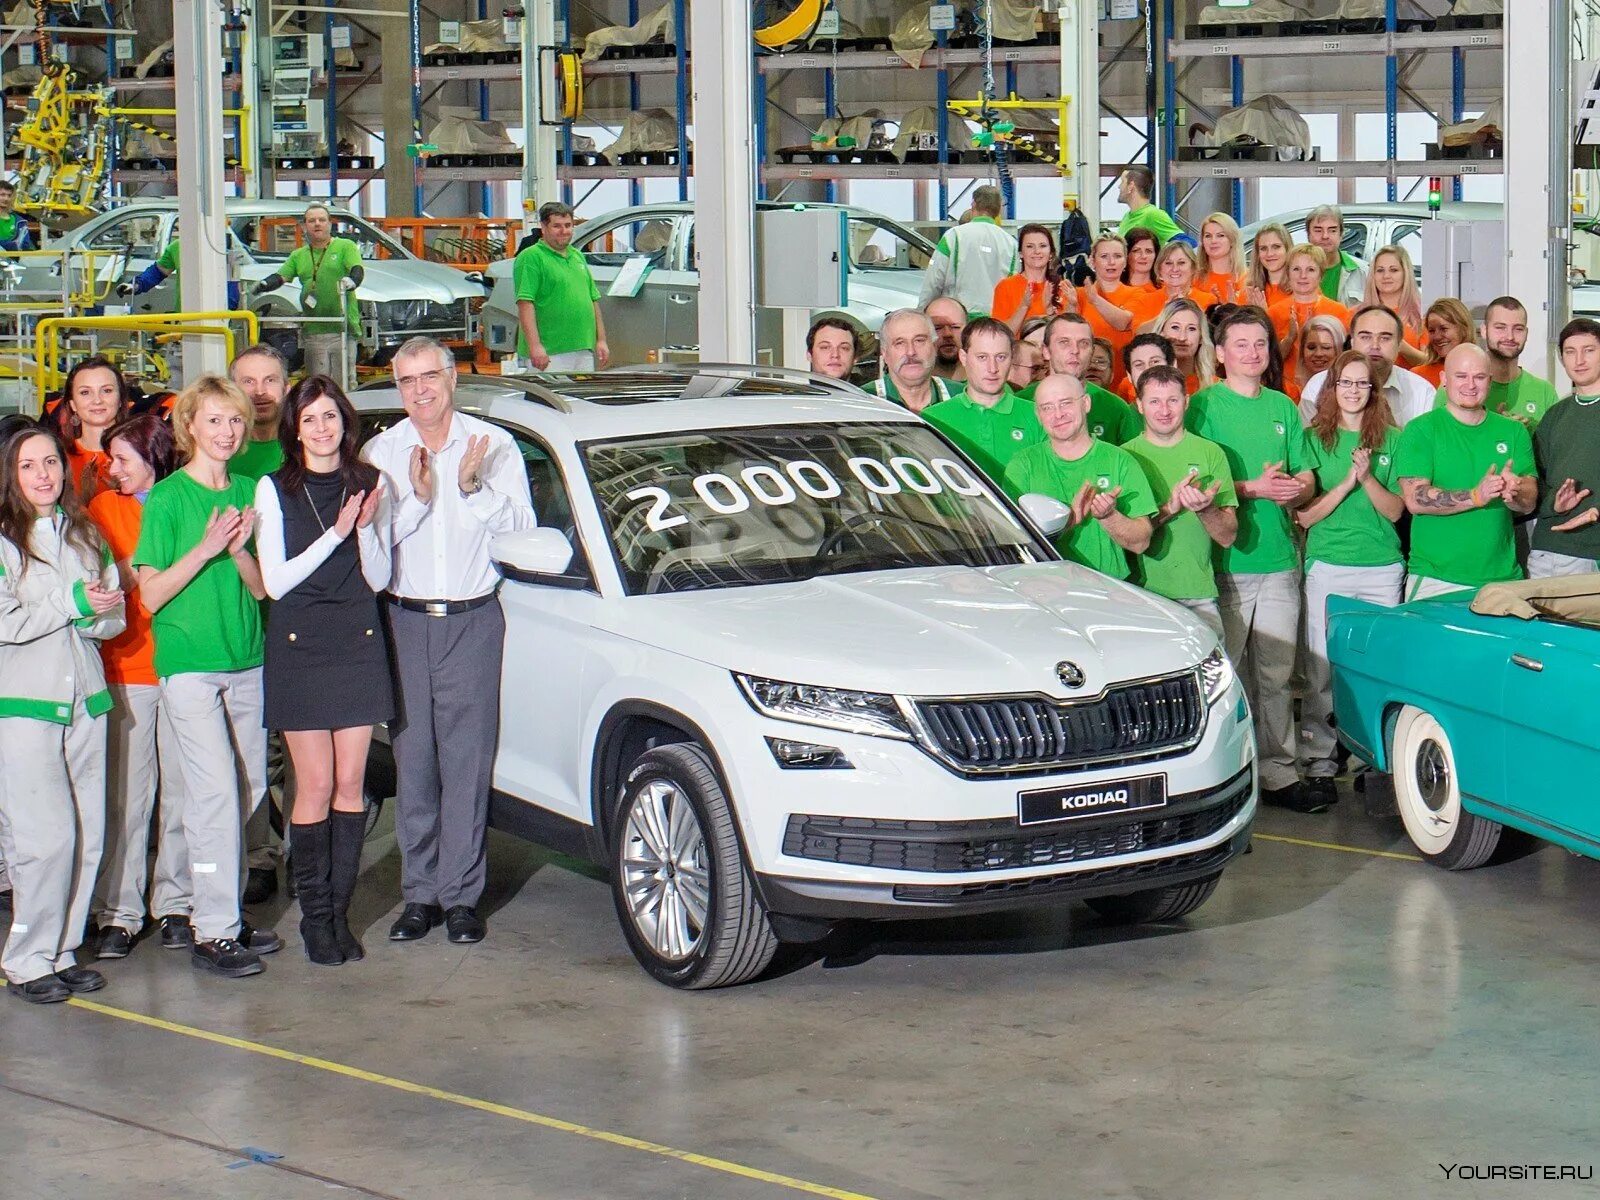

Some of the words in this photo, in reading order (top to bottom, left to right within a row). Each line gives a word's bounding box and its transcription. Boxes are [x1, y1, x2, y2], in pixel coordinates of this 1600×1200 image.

[627, 486, 689, 532] 2
[692, 460, 841, 515] 000
[847, 456, 982, 497] 000
[1061, 789, 1128, 810] KODIAQ
